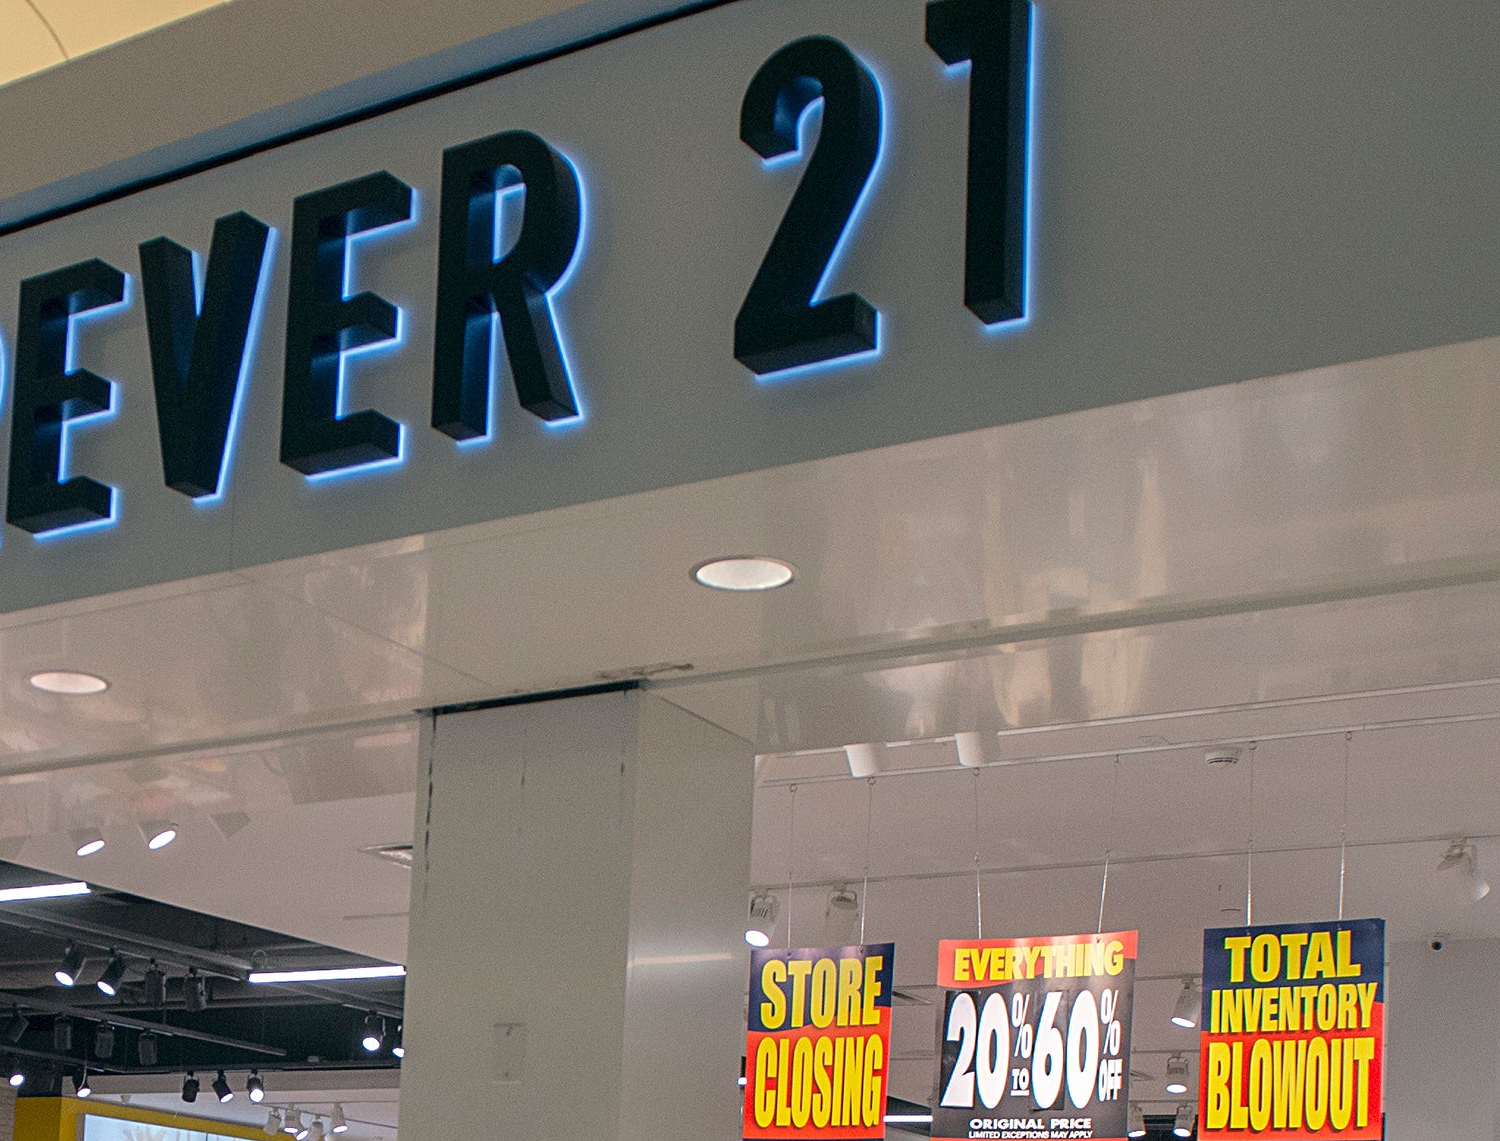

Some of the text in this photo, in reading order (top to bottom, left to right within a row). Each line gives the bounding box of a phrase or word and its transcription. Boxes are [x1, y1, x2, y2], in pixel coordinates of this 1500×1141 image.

[733, 0, 1033, 376] 21
[953, 940, 1124, 981] EVERYTHING
[1223, 929, 1362, 983] TOTAL
[760, 955, 884, 1029] STORE
[1210, 981, 1378, 1034] INVENTORY
[940, 987, 1123, 1109] 20% TO 60% OFF
[754, 1033, 884, 1128] CLOSING
[1206, 1036, 1375, 1131] BLOWOUT
[968, 1117, 1093, 1130] ORIGINAL PRICE
[968, 1130, 1094, 1139] LIMITED EXCEPTIONS MAY APPLY
